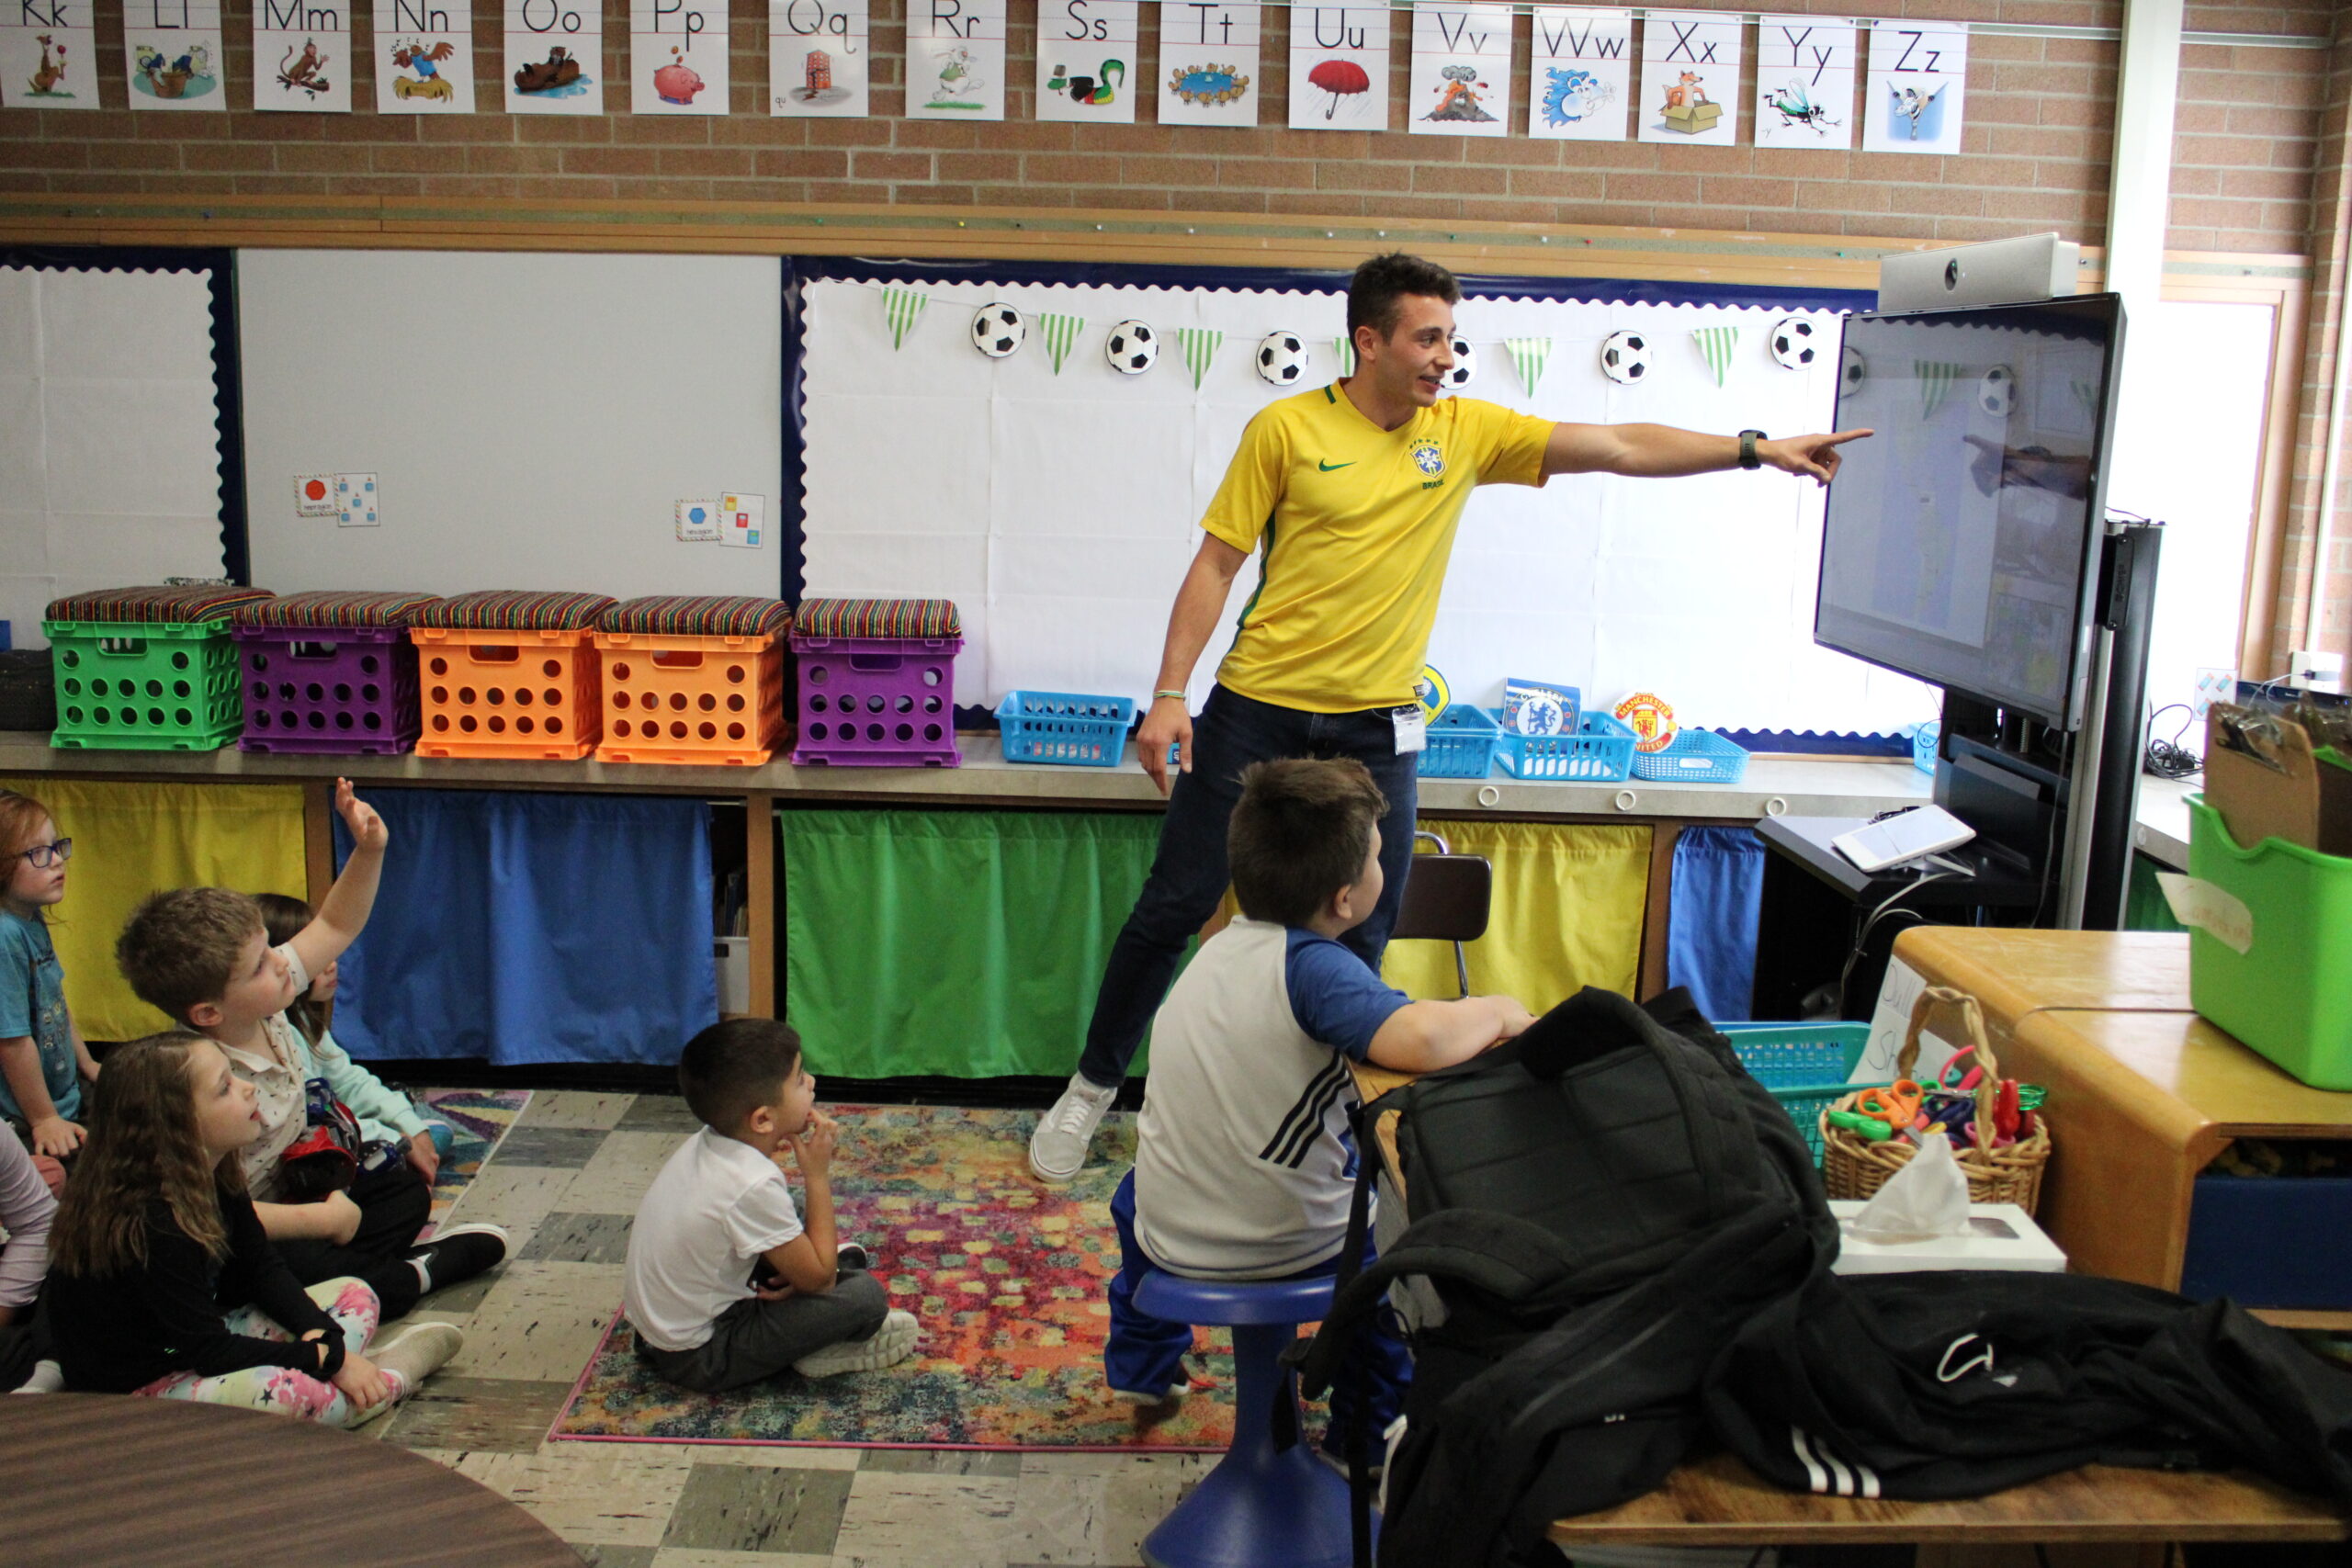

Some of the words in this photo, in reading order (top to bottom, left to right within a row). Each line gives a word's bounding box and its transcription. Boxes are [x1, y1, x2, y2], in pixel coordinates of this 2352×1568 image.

[265, 0, 337, 31] Mm
[394, 0, 448, 33] Nn
[523, 0, 582, 33] Oo
[655, 0, 705, 52] Pp
[787, 0, 857, 55] Qq
[933, 0, 980, 39] Rr
[1065, 0, 1108, 40] Ss
[1188, 3, 1234, 45] Tt
[1315, 7, 1364, 50] Uu
[1437, 11, 1488, 54] Vv
[1539, 16, 1624, 60] Ww
[1665, 20, 1718, 64] Xx
[1781, 26, 1833, 87] Yy
[1894, 30, 1941, 73] Zz
[774, 96, 786, 109] qu
[1619, 695, 1671, 716] MANCHESTER
[1635, 740, 1664, 752] NITED
